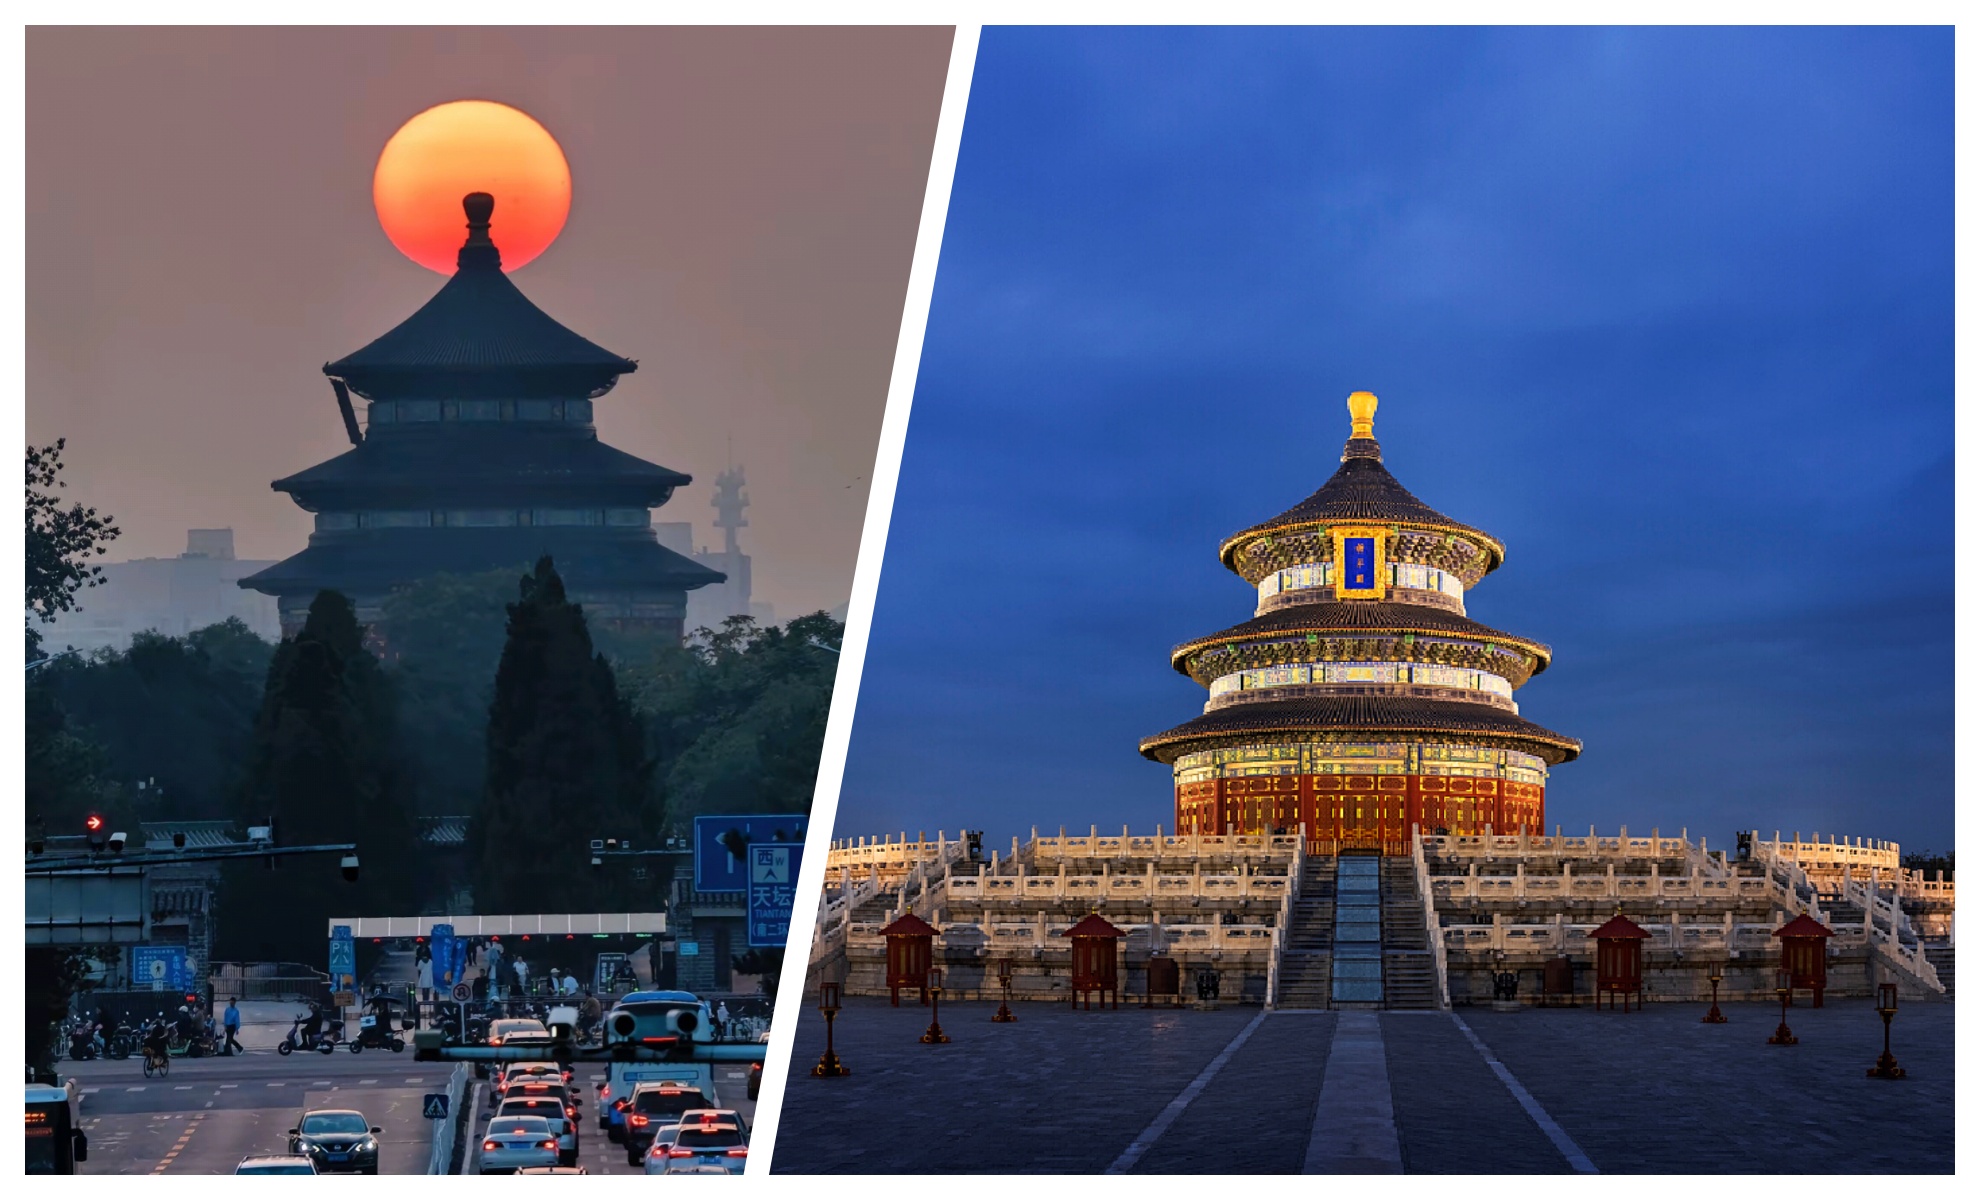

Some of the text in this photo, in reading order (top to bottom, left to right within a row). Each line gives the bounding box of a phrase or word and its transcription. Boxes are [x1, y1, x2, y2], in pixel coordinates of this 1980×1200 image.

[757, 850, 784, 866] 西 W
[753, 886, 796, 907] 天坛
[333, 943, 340, 953] P
